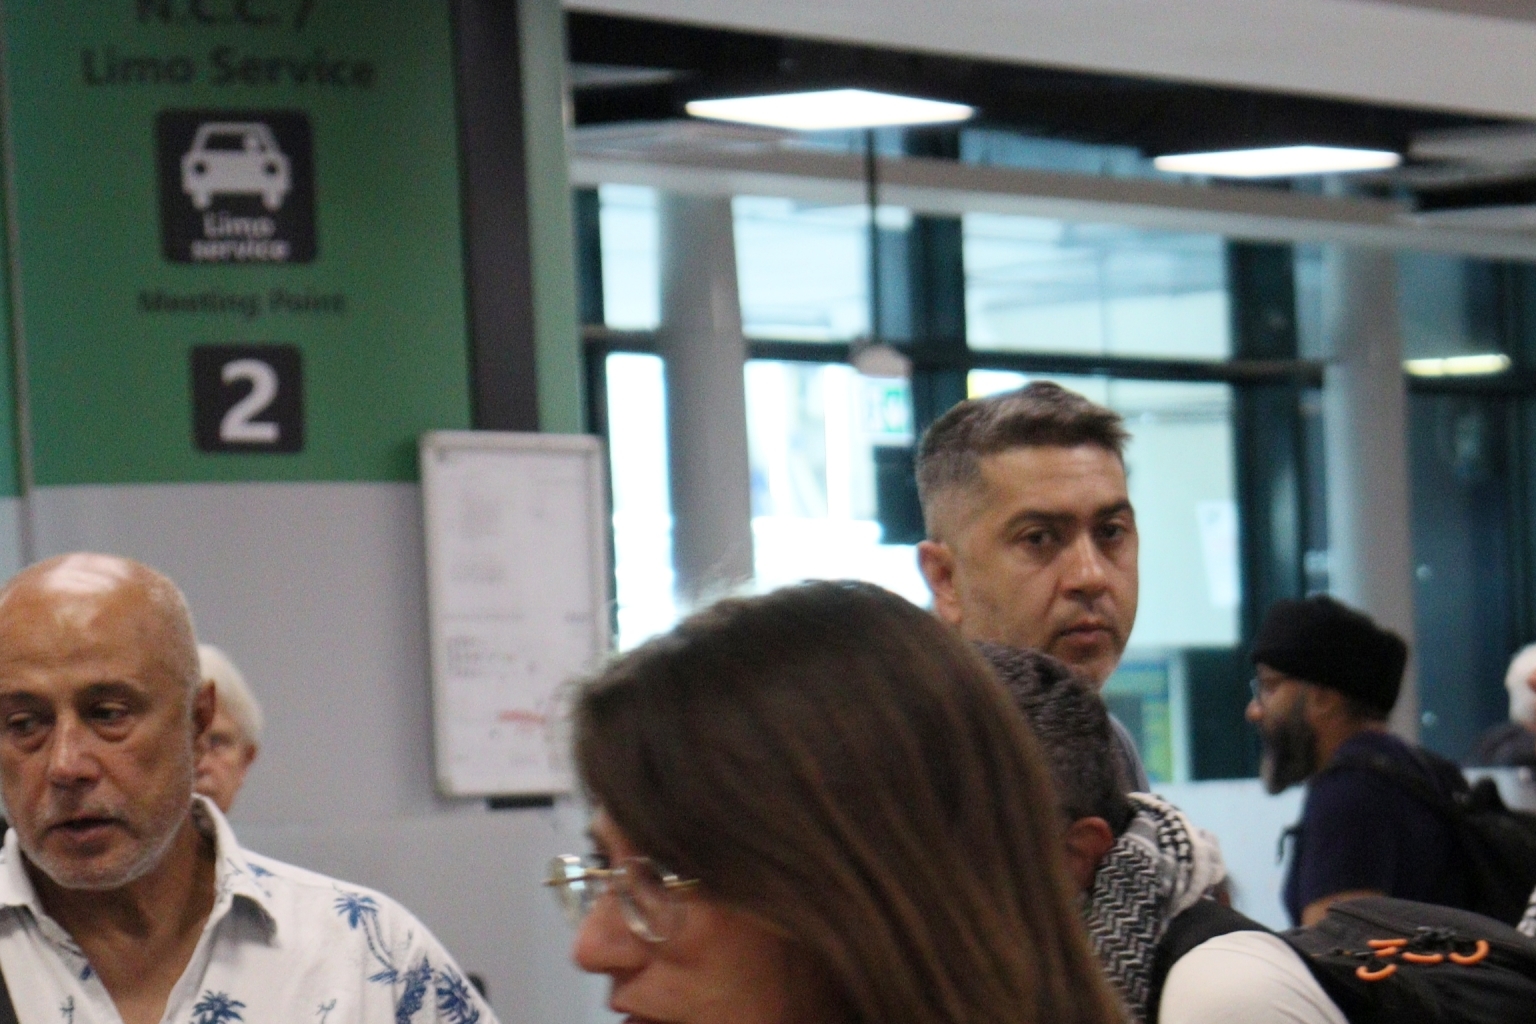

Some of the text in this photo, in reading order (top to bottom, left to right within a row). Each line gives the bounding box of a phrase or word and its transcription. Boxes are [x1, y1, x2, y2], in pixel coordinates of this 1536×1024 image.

[80, 46, 377, 88] Limo Service
[202, 210, 276, 239] Limo
[190, 240, 290, 261] service
[139, 288, 347, 319] Meeting Point
[218, 358, 282, 444] 2
